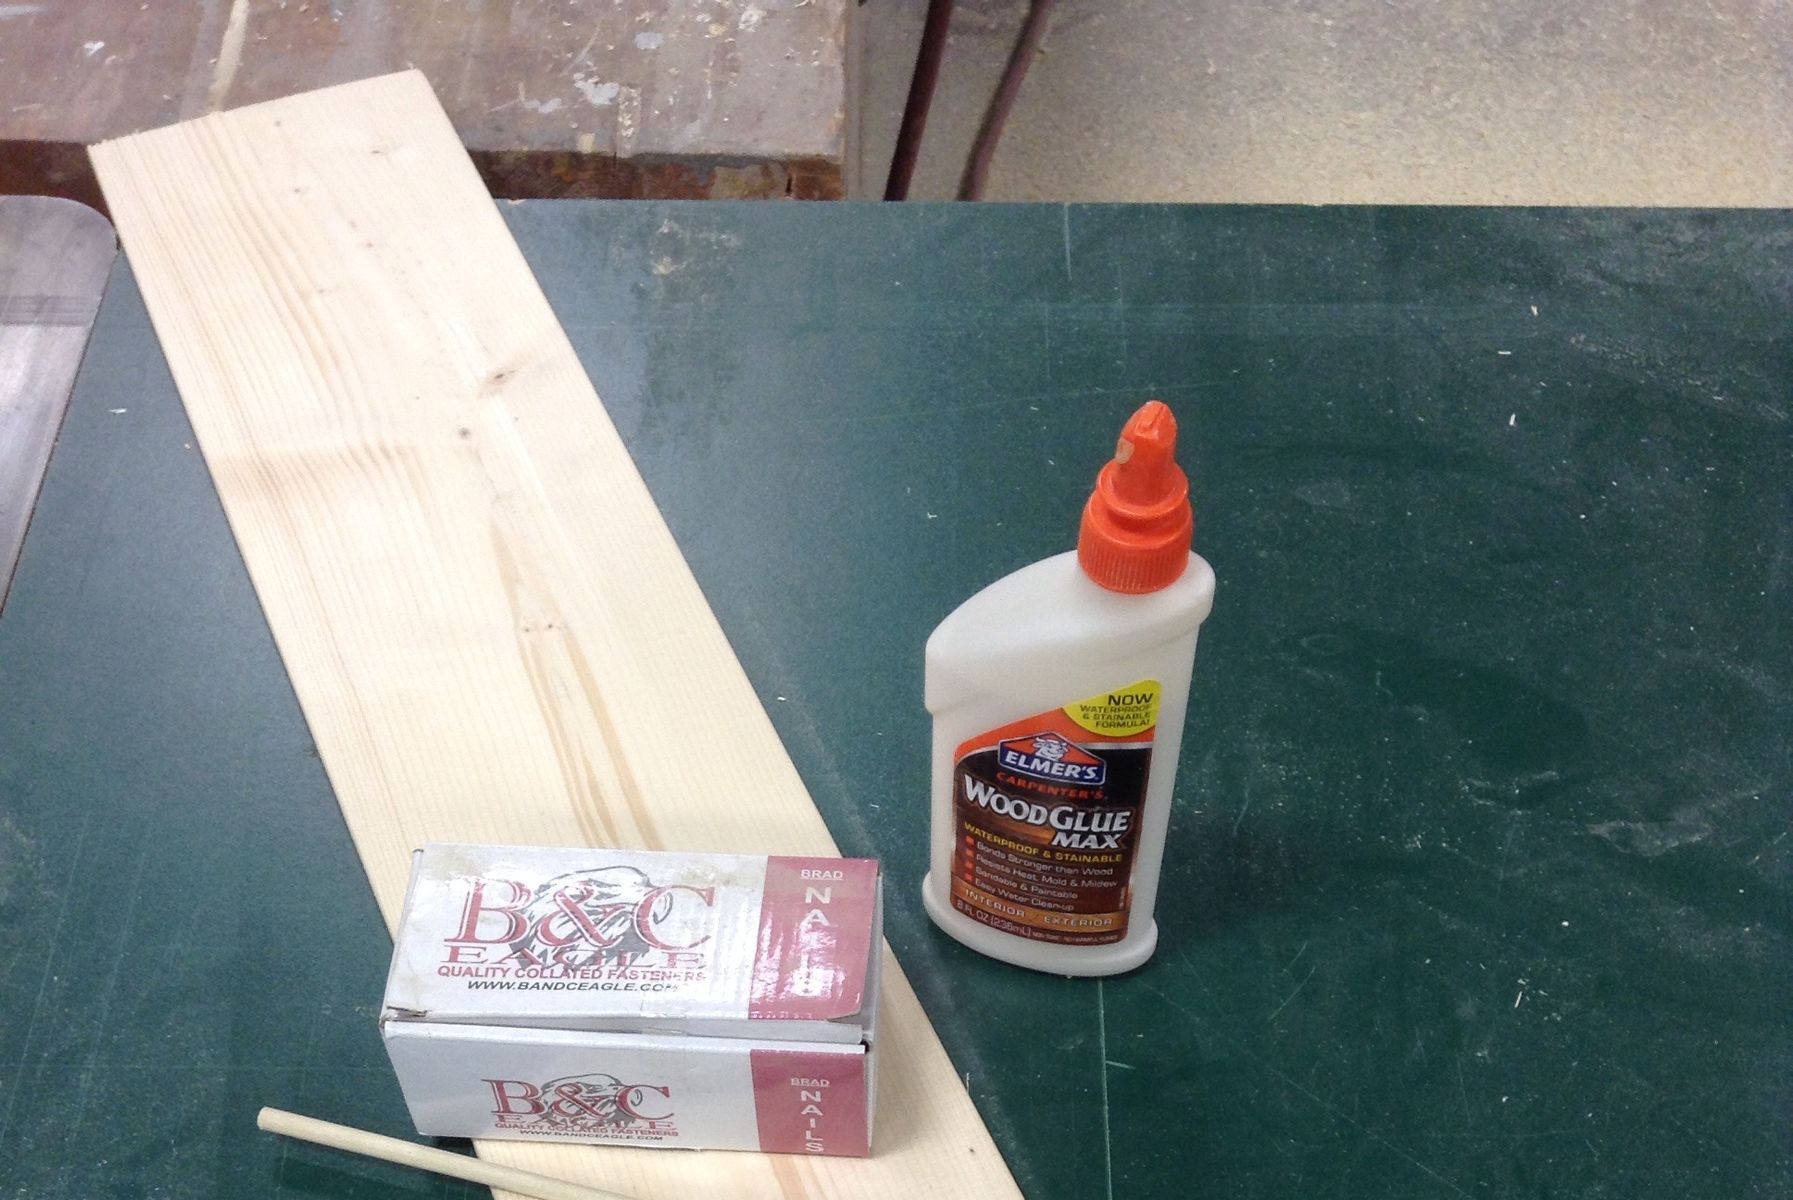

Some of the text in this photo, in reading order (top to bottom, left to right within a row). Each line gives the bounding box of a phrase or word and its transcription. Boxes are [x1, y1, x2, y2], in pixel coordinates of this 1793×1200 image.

[1108, 693, 1153, 705] NOW
[1005, 751, 1099, 780] ELMER'S
[996, 772, 1104, 799] CARPENTER'S
[964, 821, 1123, 863] WATERPROOF & STAINABLE
[1052, 831, 1121, 849] MAX
[977, 841, 1006, 859] Bonds
[1056, 866, 1079, 875] than
[1082, 868, 1113, 876] Wood
[801, 869, 844, 879] BRAD
[1042, 875, 1067, 886] Mold
[1070, 879, 1078, 887] &
[975, 878, 996, 893] Easy
[997, 888, 1028, 903] Water
[1020, 883, 1028, 891] &
[1031, 885, 1078, 899] Paintable
[444, 878, 716, 950] B&C
[965, 889, 1112, 927] INTERIOR EXTERIOR
[976, 910, 989, 921] OZ
[440, 944, 708, 970] EAGLE
[437, 966, 511, 979] QUALITY
[514, 967, 607, 980] COLLATED
[791, 1078, 830, 1087] BRAD
[481, 1078, 675, 1120] B&C
[495, 1123, 544, 1131] QUALITY
[611, 1127, 679, 1137] FASTENERS
[800, 1090, 824, 1152] NAILS
[519, 1129, 663, 1141] WWW.BANDCEAGLE.COM
